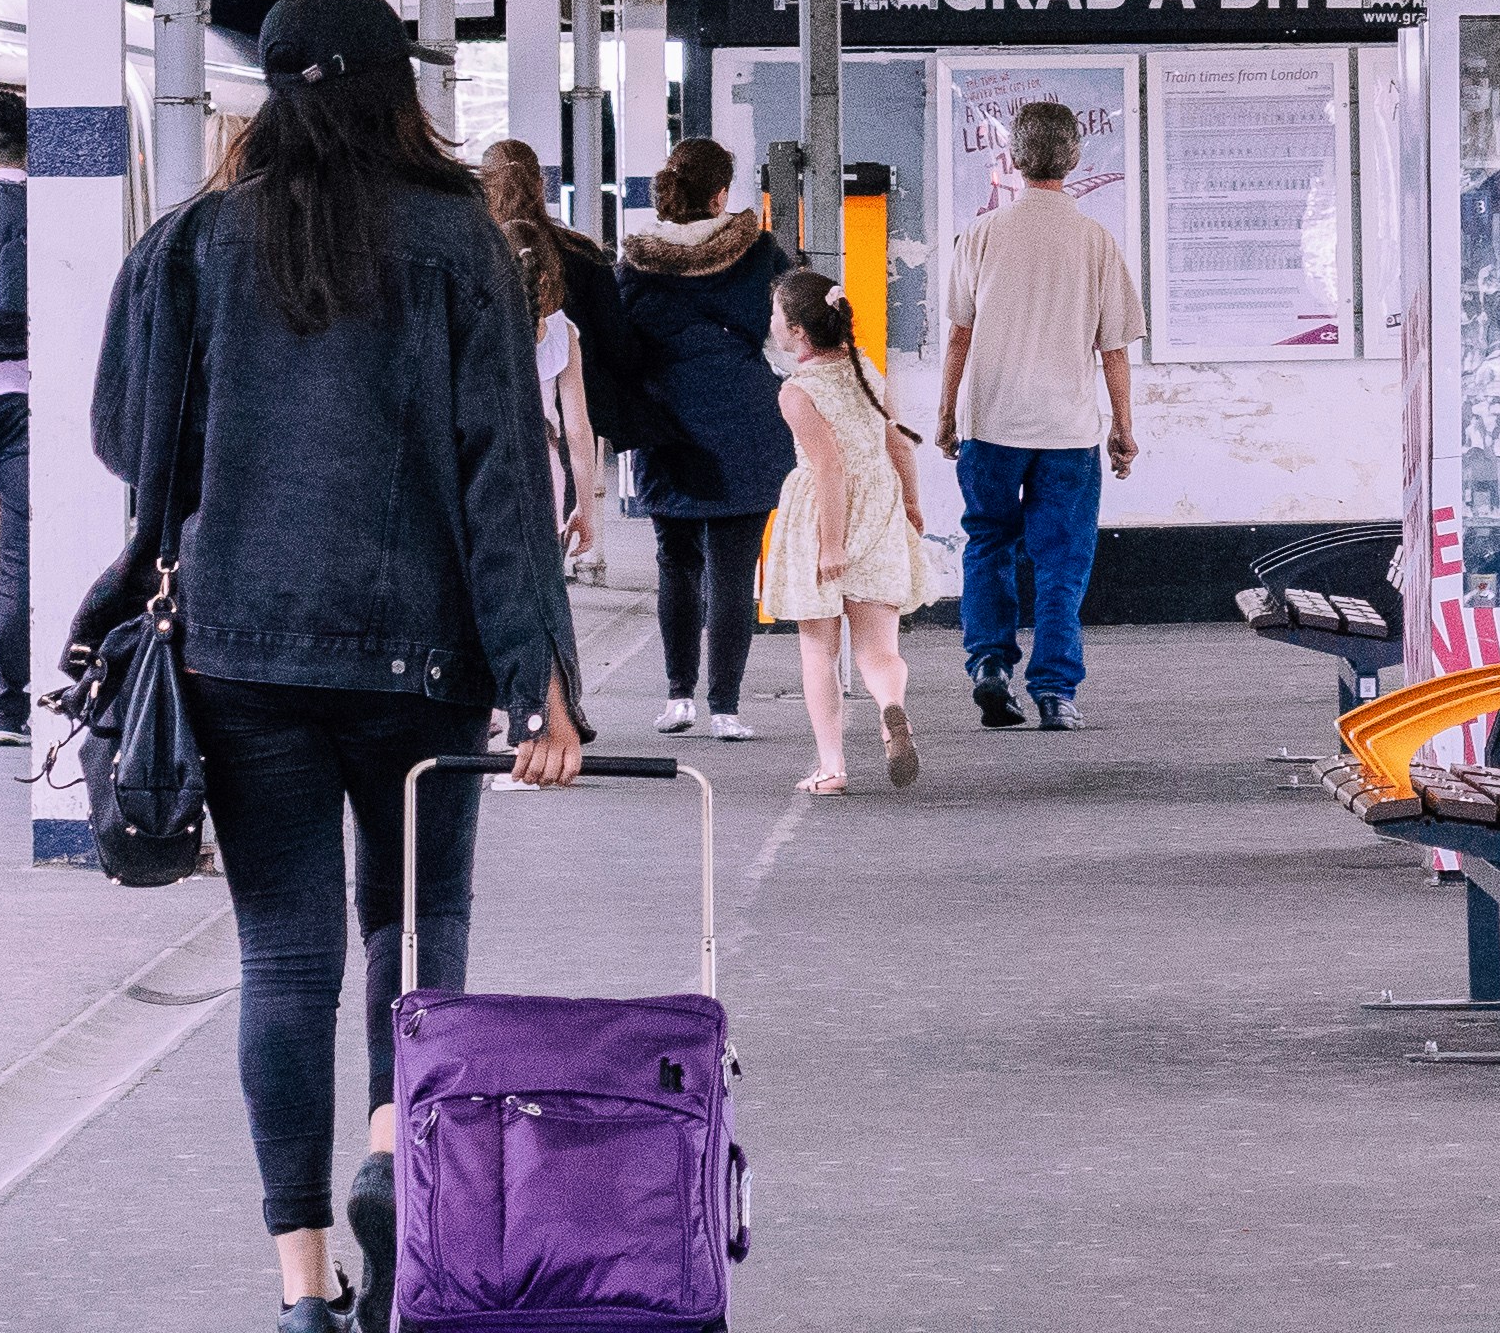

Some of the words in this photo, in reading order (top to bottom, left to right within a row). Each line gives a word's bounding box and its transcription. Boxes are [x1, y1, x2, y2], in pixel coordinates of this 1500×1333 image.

[1164, 70, 1196, 83] Train
[1199, 70, 1235, 82] times
[1237, 69, 1268, 84] from
[1270, 67, 1319, 81] London
[965, 106, 975, 123] A
[978, 101, 1002, 118] SEA
[1320, 331, 1338, 341] c2c
